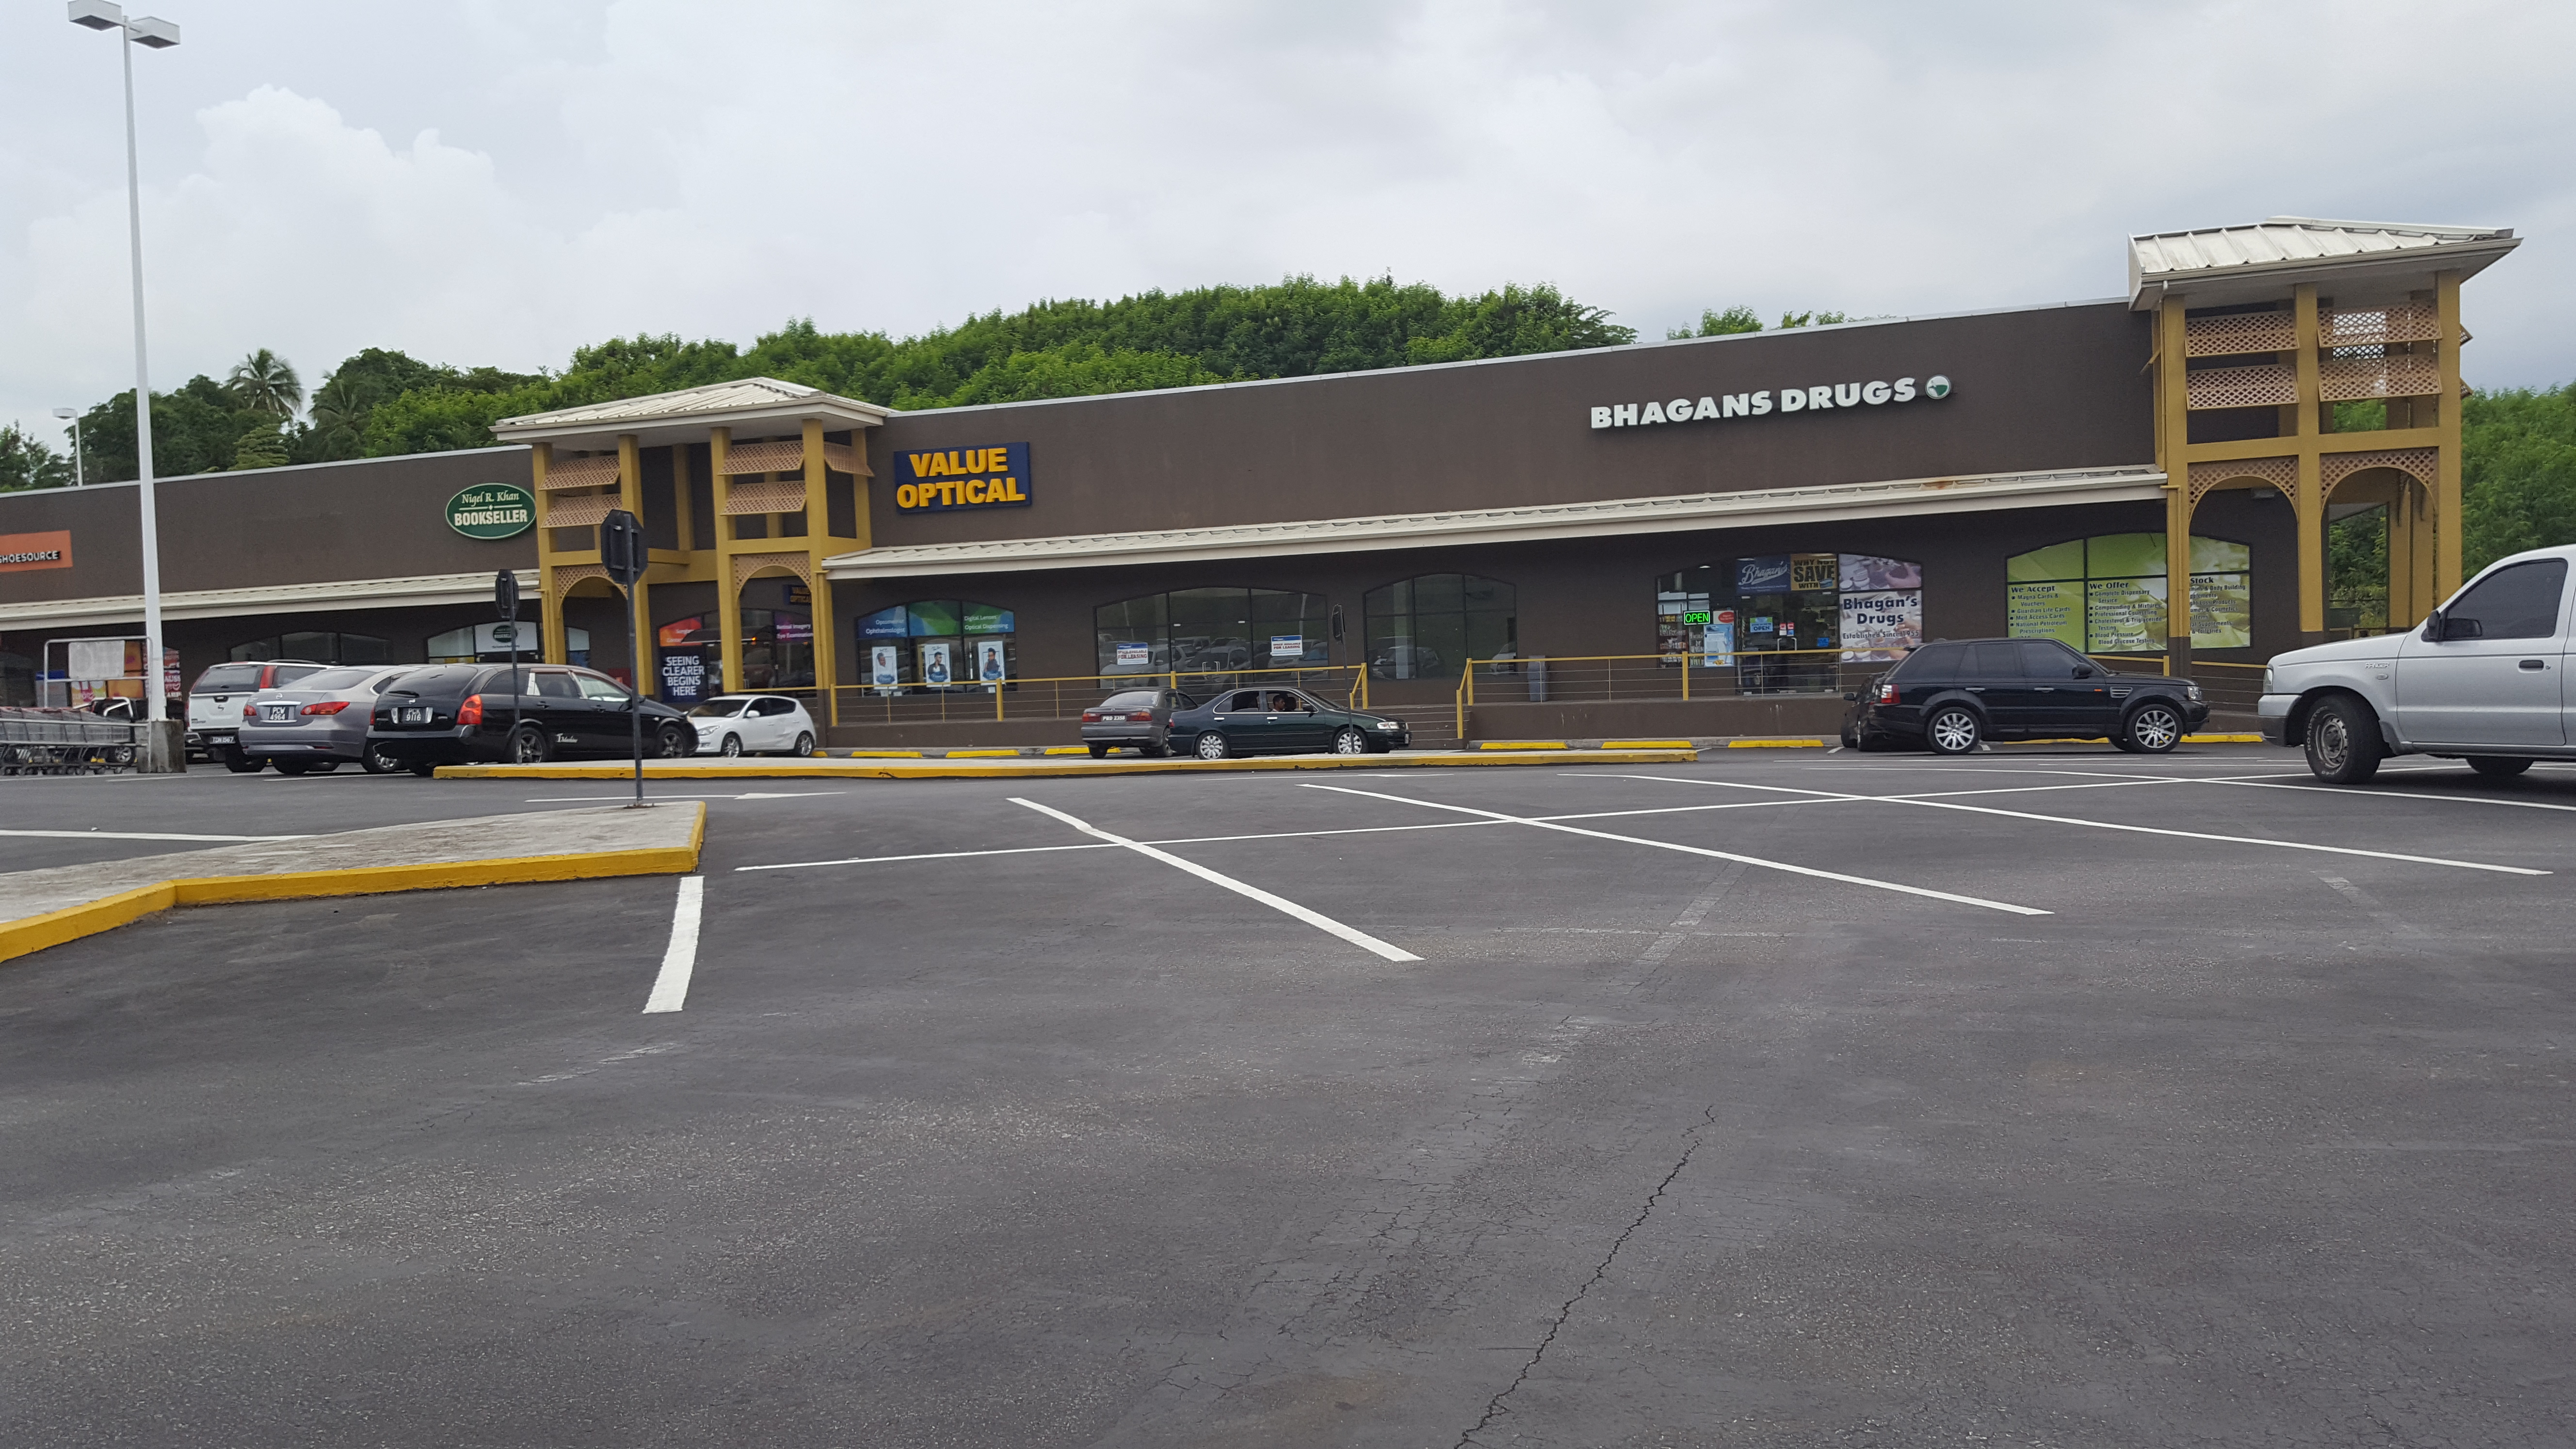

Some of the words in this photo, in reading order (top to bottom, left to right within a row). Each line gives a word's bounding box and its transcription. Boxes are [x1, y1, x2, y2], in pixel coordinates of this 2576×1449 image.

[1591, 390, 1772, 429] BHAGANS
[1781, 377, 1916, 413] DRUGS
[908, 448, 1008, 478] VALUE
[462, 491, 485, 507] Nigel
[497, 490, 519, 501] Khan
[897, 477, 1026, 508] OPTICAL
[454, 509, 528, 526] BOOKSELLER
[1794, 565, 1835, 582] SAVE
[1843, 596, 1918, 612] Bhagan's
[1685, 613, 1708, 622] OPEN
[1857, 613, 1904, 626] Drugs
[666, 656, 700, 666] SEEING
[662, 666, 705, 676] CLEARER
[667, 676, 701, 686] BEGINS
[673, 686, 697, 696] HERE
